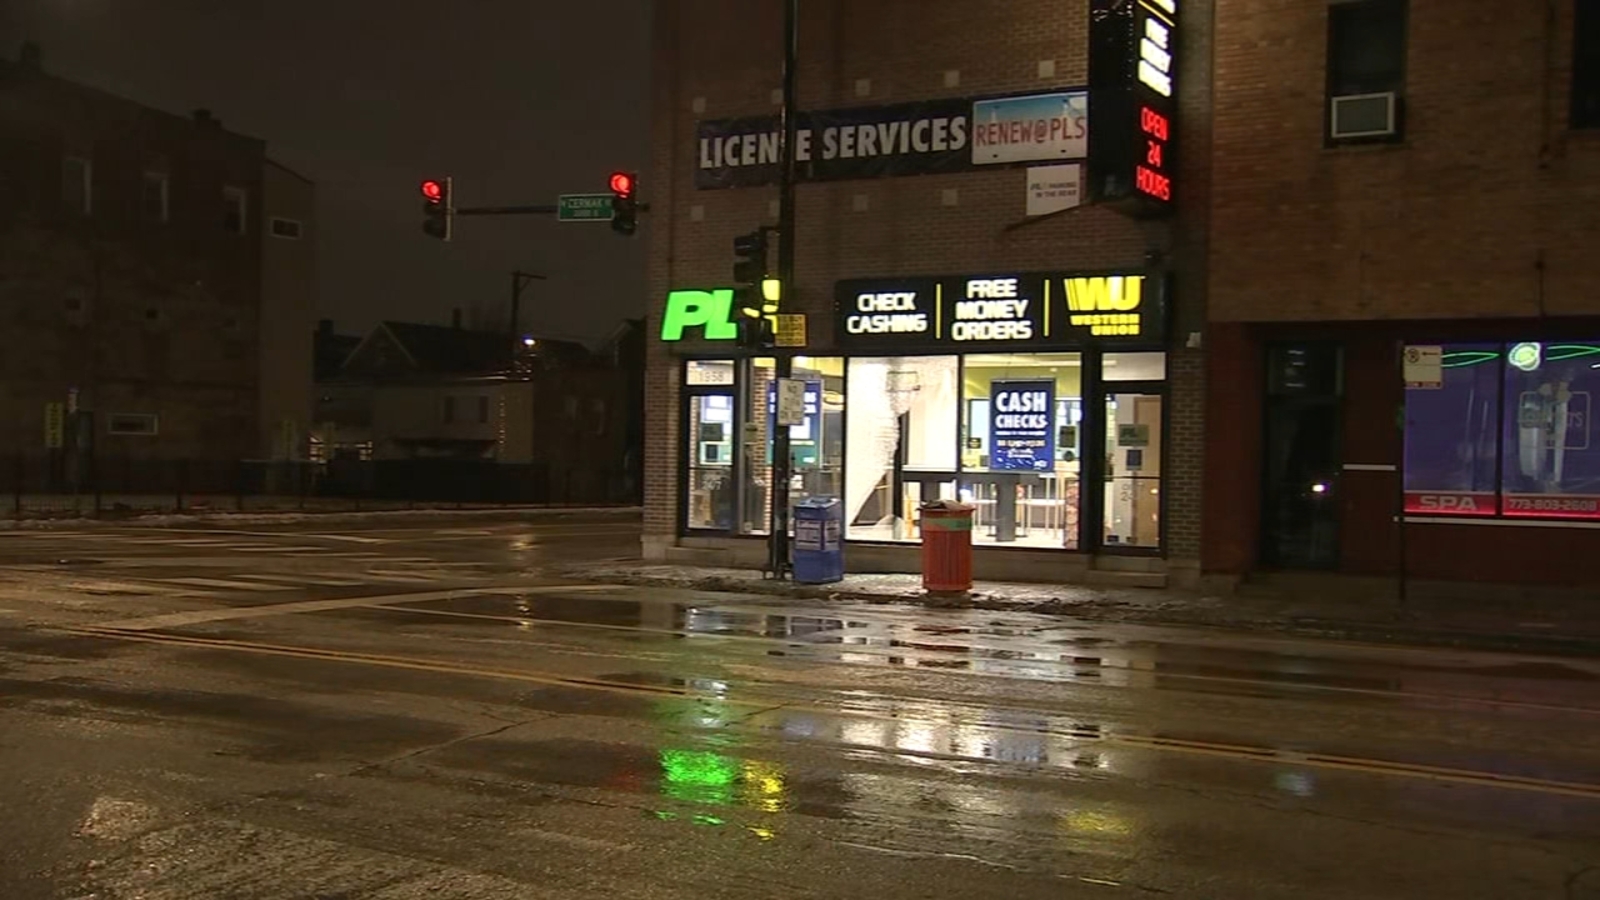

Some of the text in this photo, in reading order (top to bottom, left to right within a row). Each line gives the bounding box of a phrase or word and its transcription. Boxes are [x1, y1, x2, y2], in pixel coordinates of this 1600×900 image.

[975, 116, 1086, 146] RENEW@PLS
[1140, 106, 1169, 141] OPEN
[700, 116, 966, 168] LICENE SERVICES
[1147, 140, 1162, 168] 24
[1136, 165, 1171, 201] HOURS
[967, 278, 1018, 299] FREE
[1064, 275, 1142, 311] WU
[857, 292, 916, 312] CHECK
[955, 299, 1029, 320] MONEY
[846, 314, 928, 334] CASHING
[1070, 313, 1141, 326] WESTERN
[951, 320, 1032, 341] ORDERS
[1090, 325, 1141, 336] UNION
[699, 371, 724, 382] 1958
[995, 392, 1047, 413] CASH
[995, 414, 1047, 429] CHECKS
[1420, 496, 1477, 510] SPA
